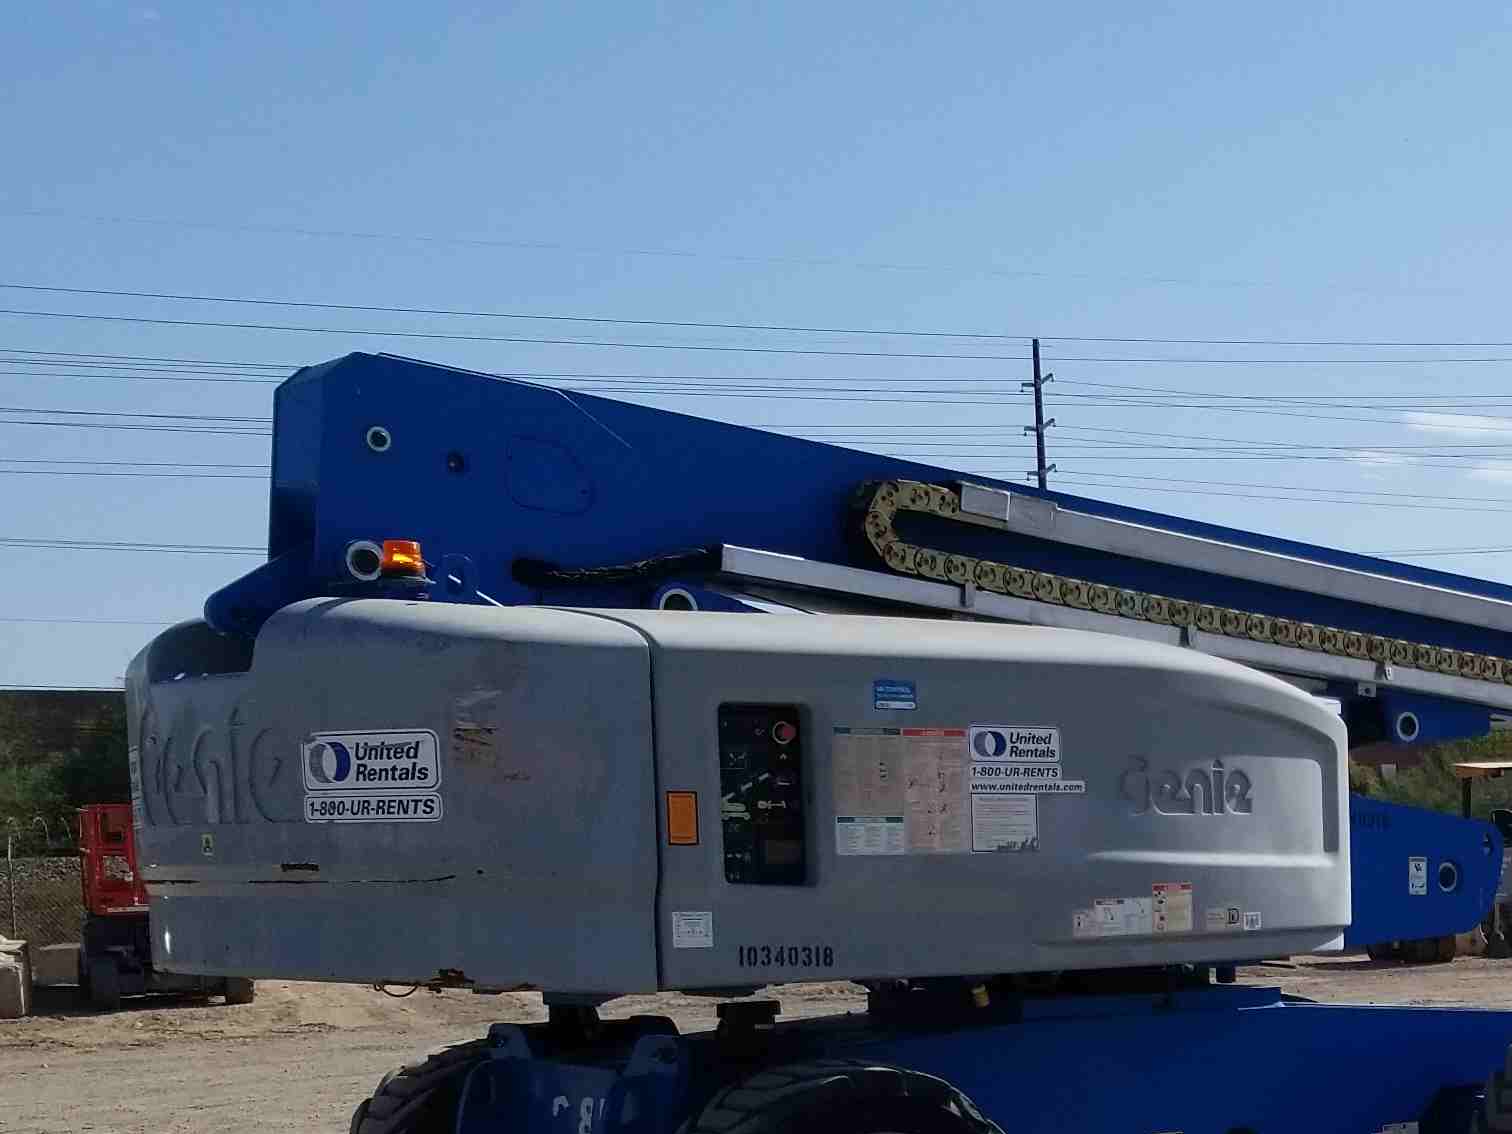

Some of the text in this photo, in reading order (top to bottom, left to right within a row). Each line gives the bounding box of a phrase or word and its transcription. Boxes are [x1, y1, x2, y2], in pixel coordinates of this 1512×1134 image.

[1009, 732, 1052, 745] United
[355, 740, 420, 761] United
[1009, 745, 1056, 758] Rentals
[356, 762, 429, 782] Rentals
[971, 767, 1058, 777] 1-800-UR-RENTS
[971, 782, 1083, 792] www.unitedrentals.com
[1119, 756, 1253, 816] Genie
[309, 798, 435, 816] 1-800-UR-RENTS
[738, 946, 834, 967] 10340318
